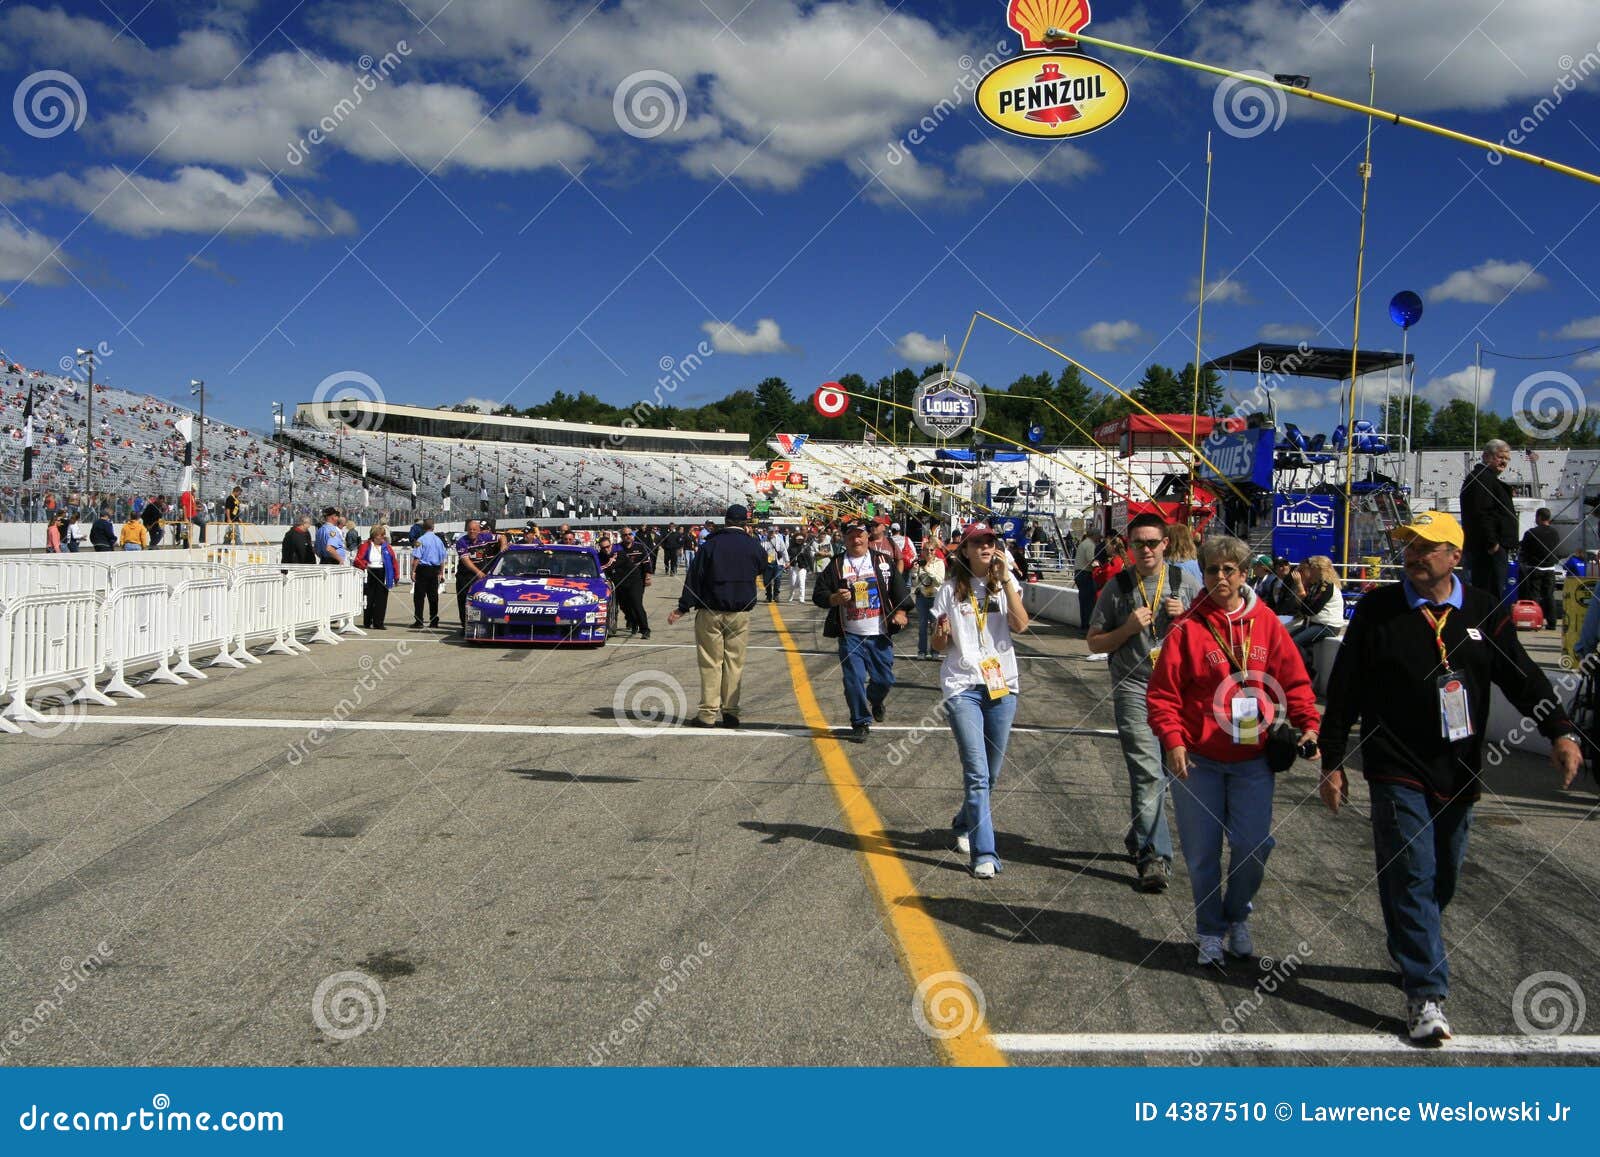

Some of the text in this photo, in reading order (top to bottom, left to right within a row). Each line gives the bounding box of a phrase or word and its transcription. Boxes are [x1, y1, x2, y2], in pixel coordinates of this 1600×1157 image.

[999, 75, 1107, 115] PENNZOIL
[926, 398, 970, 413] LOWE'S
[1200, 438, 1253, 478] LOWE'S
[766, 461, 791, 482] 2
[1283, 510, 1328, 524] LOWE'S
[484, 578, 590, 590] FedEx
[543, 585, 593, 596] Express
[505, 606, 559, 615] IMPALA SS
